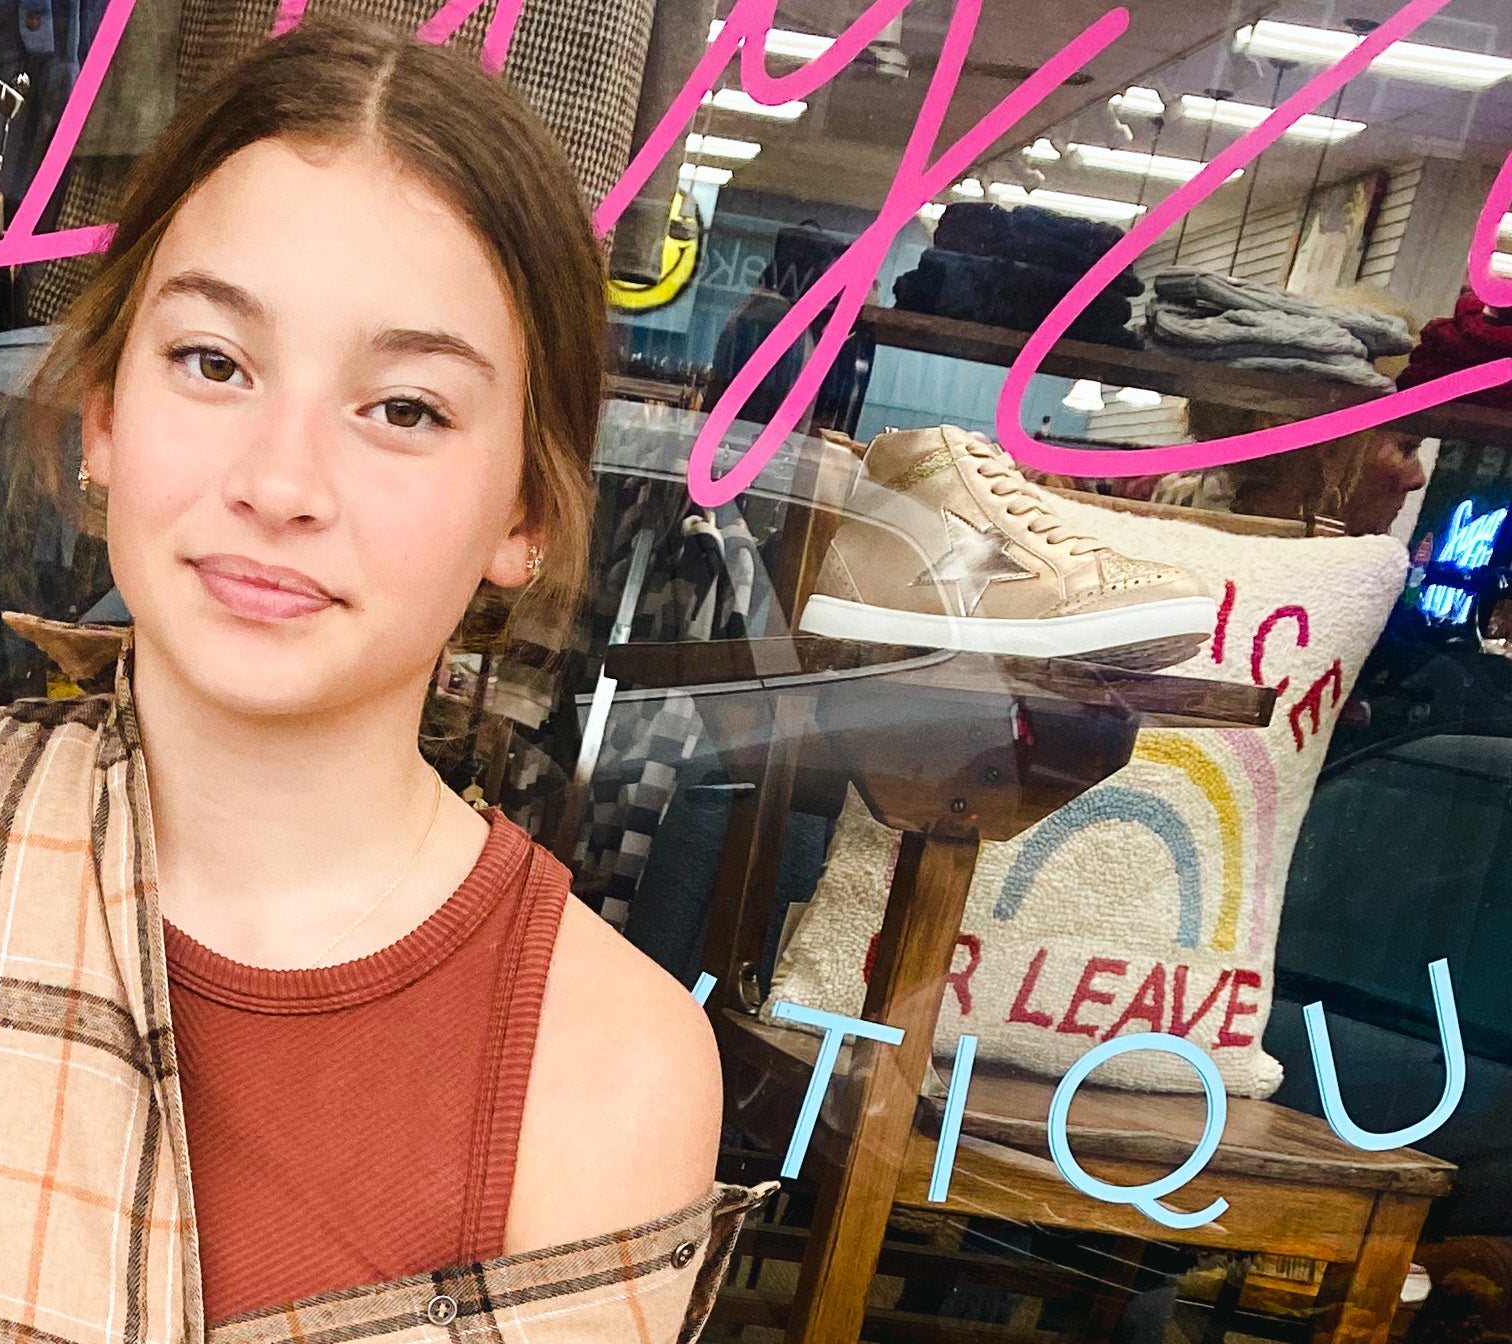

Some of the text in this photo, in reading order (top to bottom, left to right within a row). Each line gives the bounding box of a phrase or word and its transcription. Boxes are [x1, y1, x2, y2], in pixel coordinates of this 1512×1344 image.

[864, 932, 1262, 1051] R LEAVE
[691, 957, 1467, 1229] TIQU
